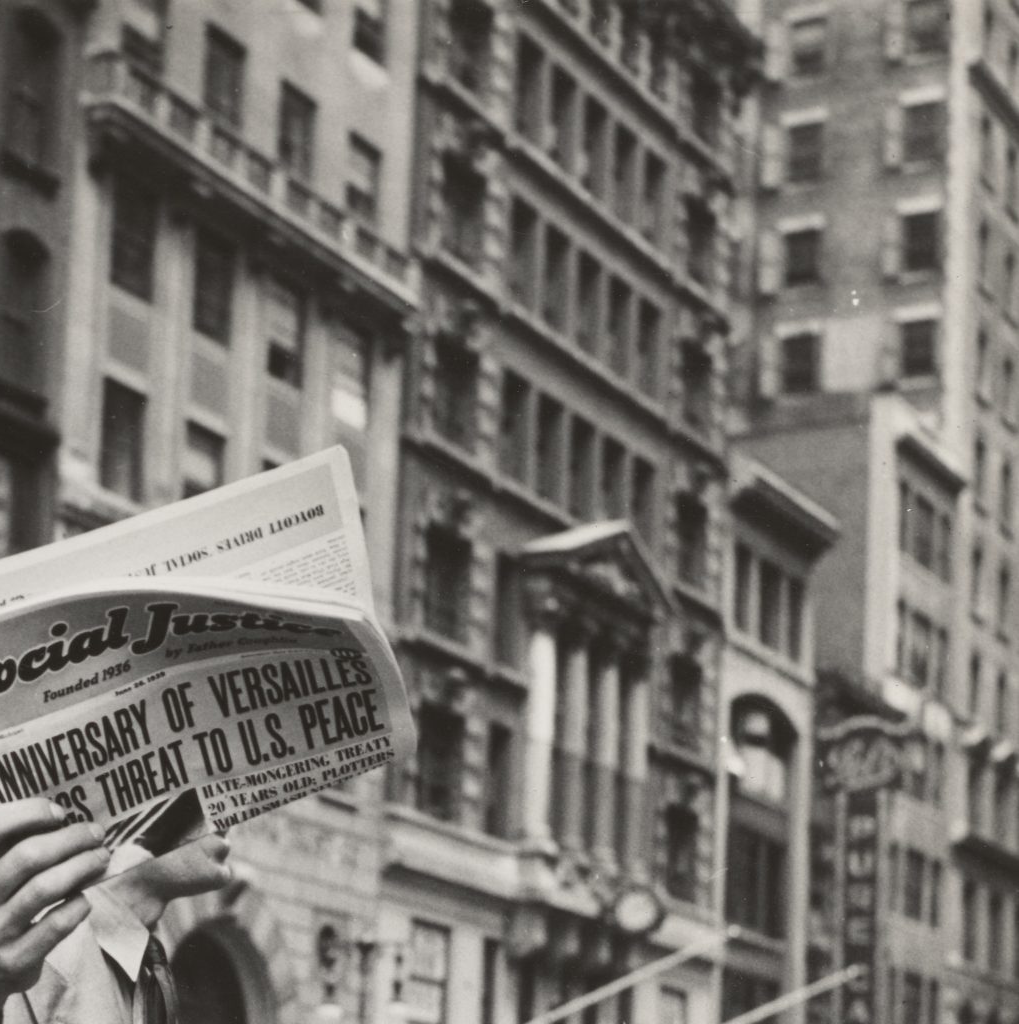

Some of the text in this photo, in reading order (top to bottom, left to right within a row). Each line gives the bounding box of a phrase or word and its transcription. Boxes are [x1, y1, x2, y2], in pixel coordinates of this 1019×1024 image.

[216, 526, 264, 551] DRIVES
[269, 504, 326, 535] BOYCOTT
[131, 602, 343, 654] Justice
[164, 645, 181, 659] by
[188, 639, 231, 653] Father
[43, 659, 131, 703] Founded 1936
[115, 686, 132, 696] June
[147, 671, 165, 682] 1939
[162, 682, 194, 733] OF
[207, 657, 372, 718] VERSAILLES
[95, 740, 189, 817] THREAT
[192, 727, 233, 776] TO
[237, 713, 296, 766] U.S.
[298, 688, 384, 750] PEACE
[202, 754, 330, 799] HATE-MONGERING
[334, 735, 392, 762] TREATY
[208, 802, 226, 816] 20
[230, 786, 278, 808] YEARS
[321, 749, 395, 781] PLOTTERS
